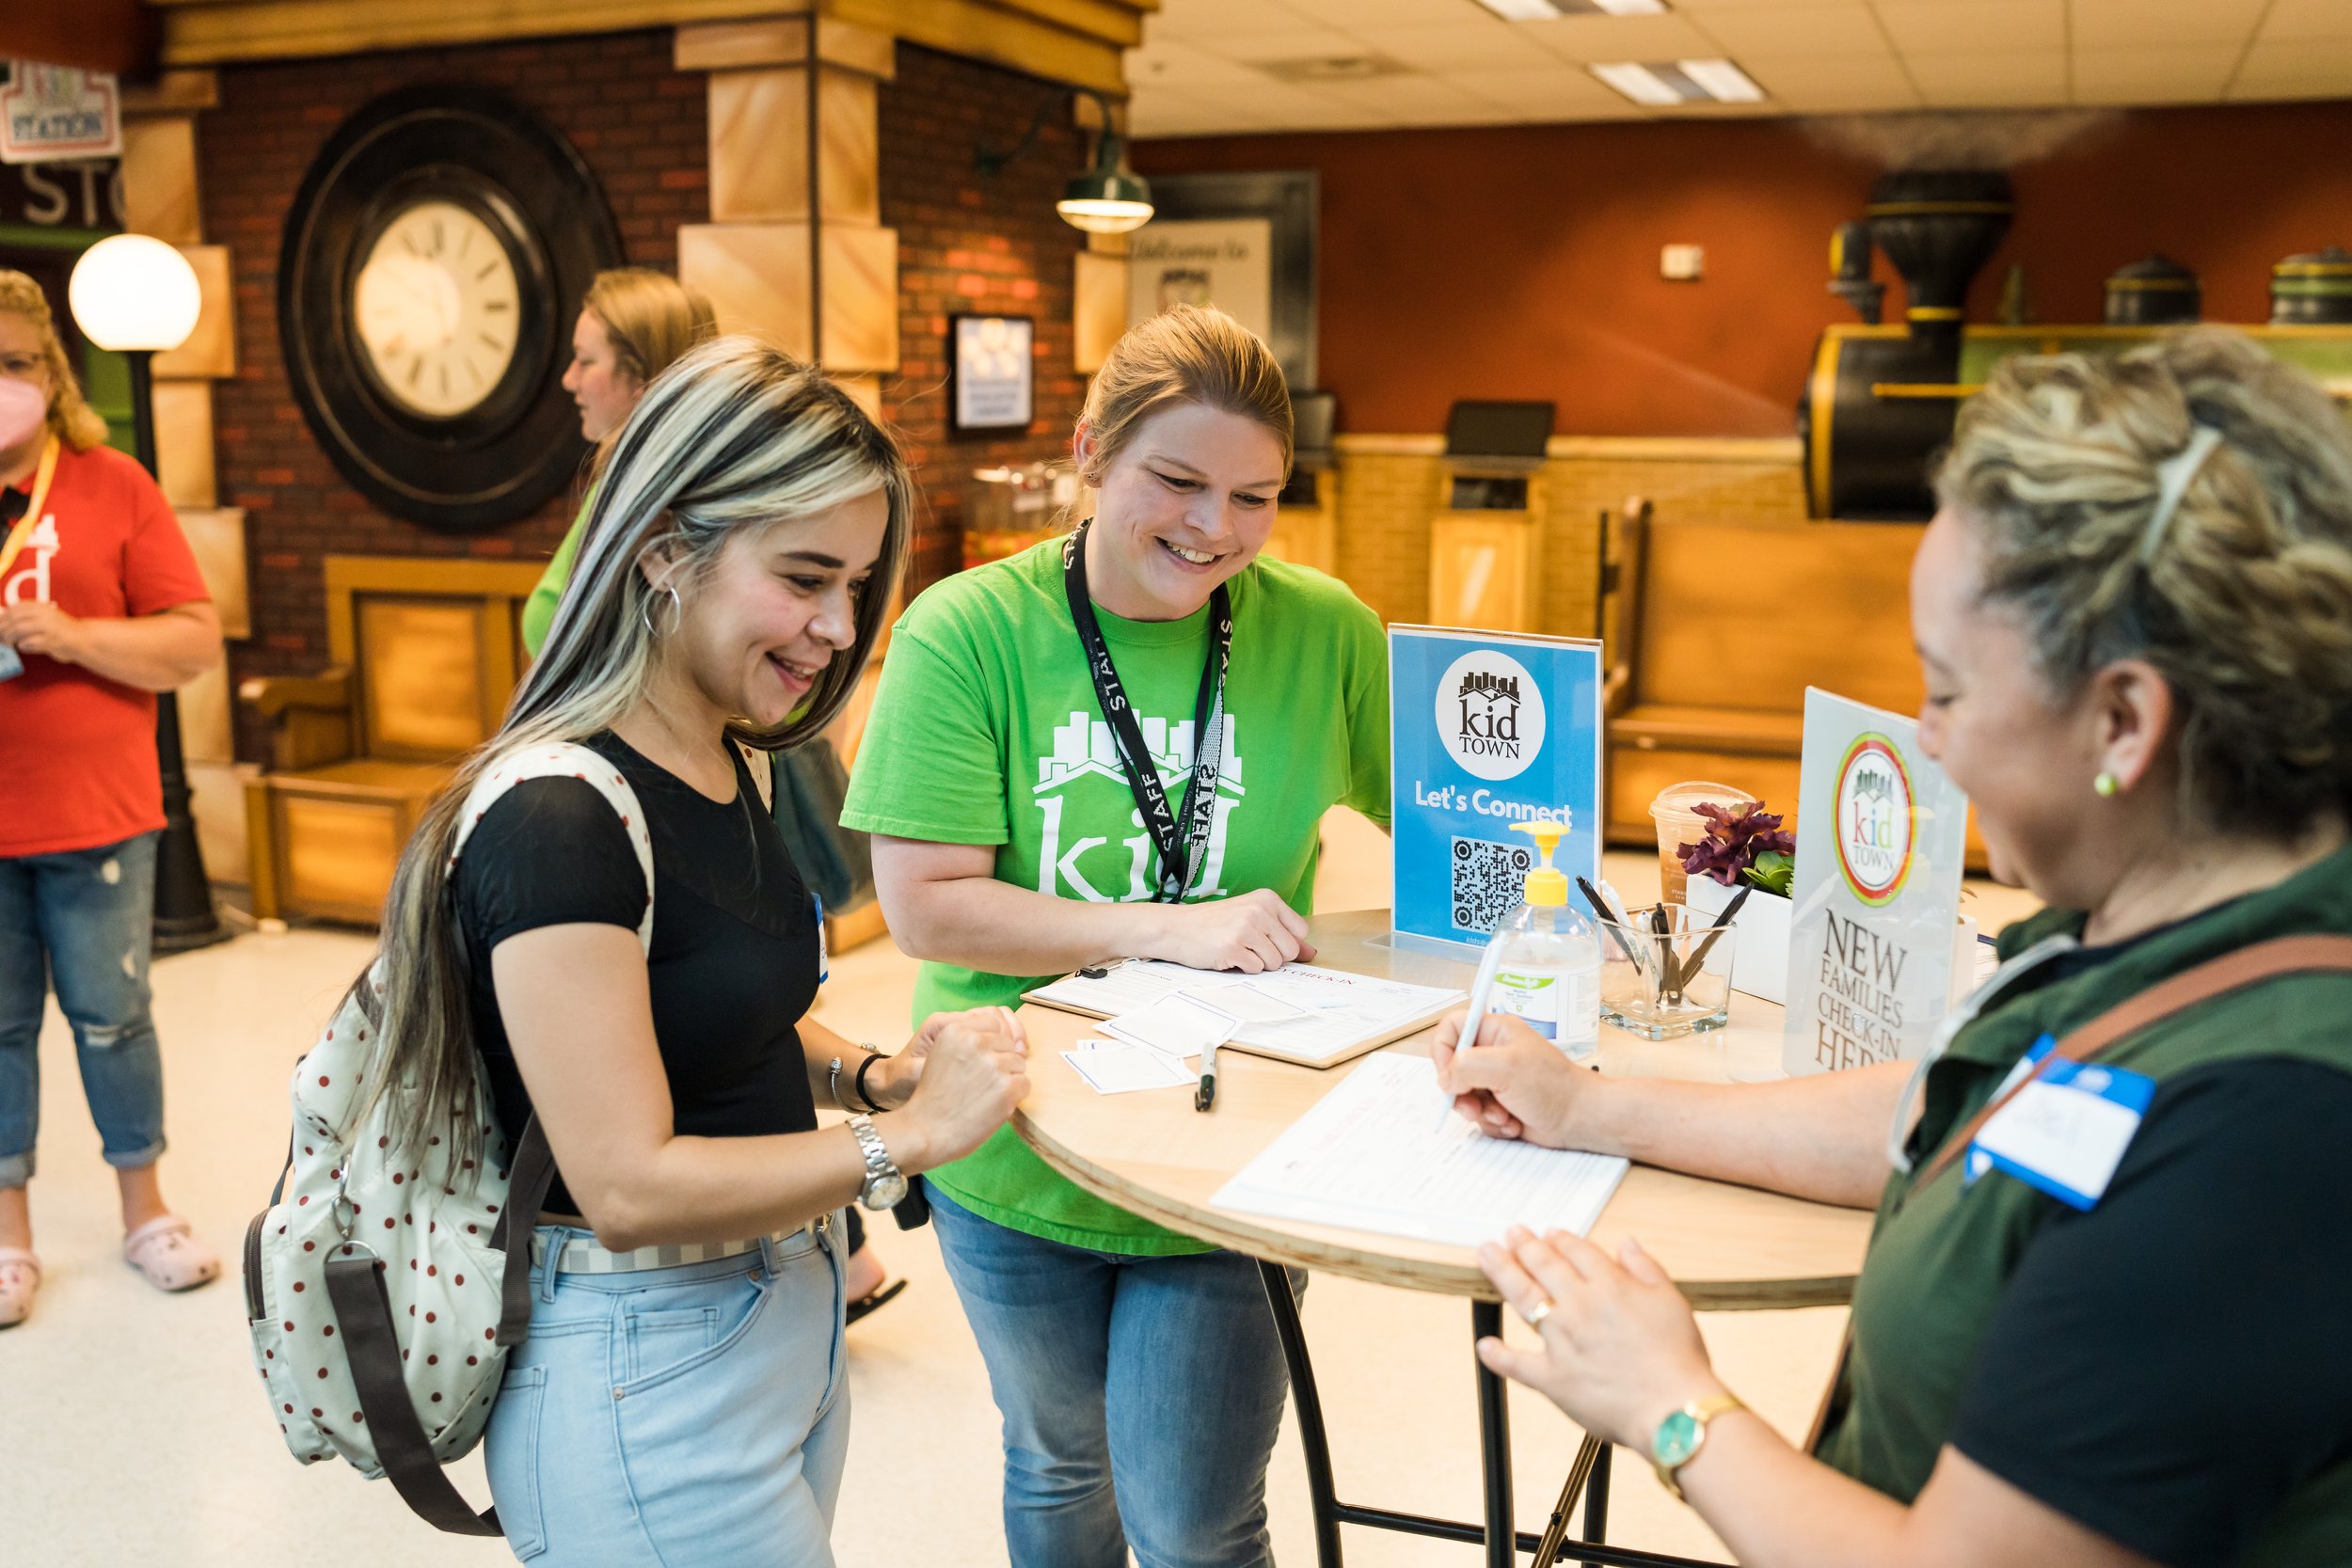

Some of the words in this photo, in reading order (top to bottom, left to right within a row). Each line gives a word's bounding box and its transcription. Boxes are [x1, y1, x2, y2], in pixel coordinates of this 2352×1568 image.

[1459, 698, 1520, 741] kid
[1458, 736, 1520, 760] TOWN
[1415, 780, 1468, 812] Let's
[1471, 788, 1573, 828] Connect
[1852, 800, 1894, 848] kid
[1852, 845, 1894, 871] TOWN
[1823, 908, 1908, 992] NEW
[1820, 957, 1903, 1029] FAMILIES
[1815, 1018, 1883, 1070] HER
[1818, 990, 1901, 1061] CHECK-IN
